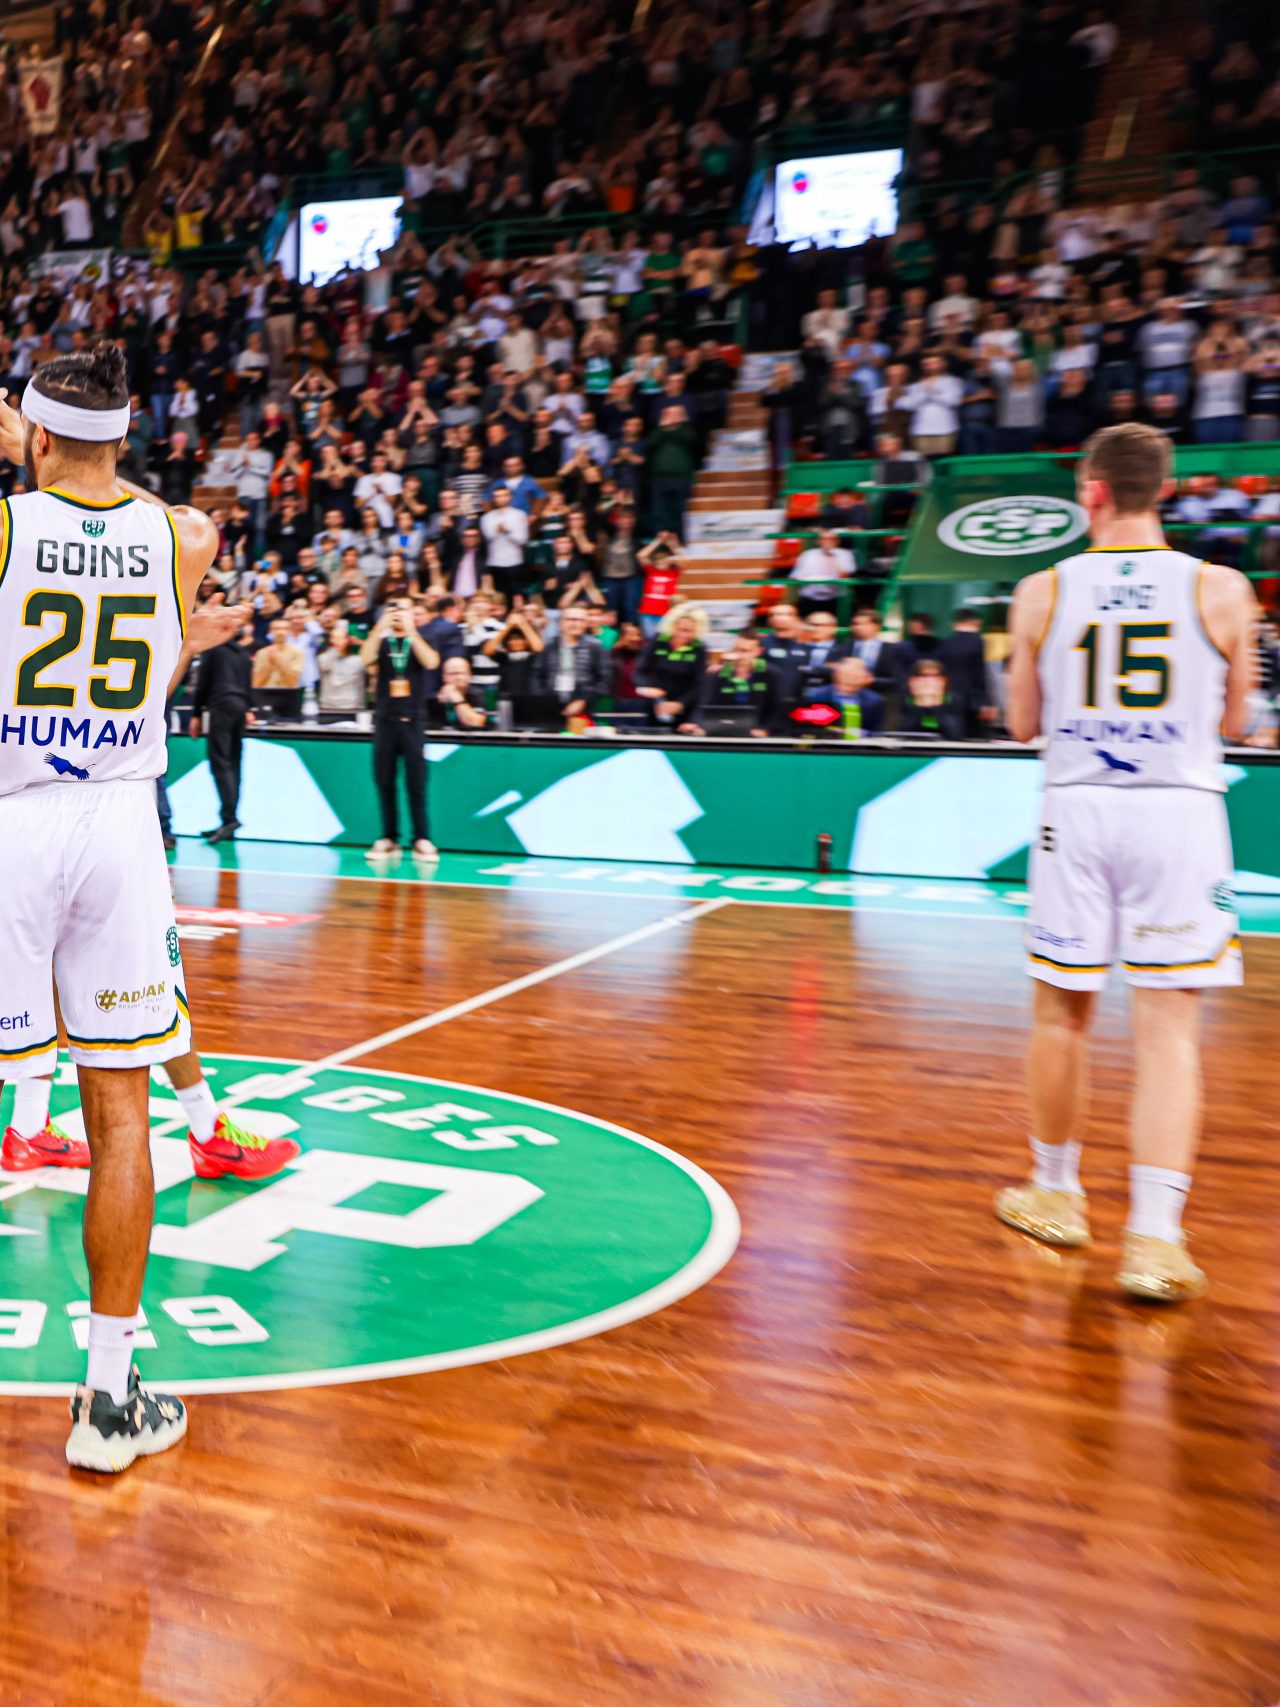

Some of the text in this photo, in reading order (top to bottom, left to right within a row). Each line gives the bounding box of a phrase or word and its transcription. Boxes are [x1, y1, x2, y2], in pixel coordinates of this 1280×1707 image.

[36, 539, 149, 578] GOINS
[14, 587, 158, 712] 25
[1072, 621, 1176, 711] 15
[0, 713, 146, 749] HUMAN
